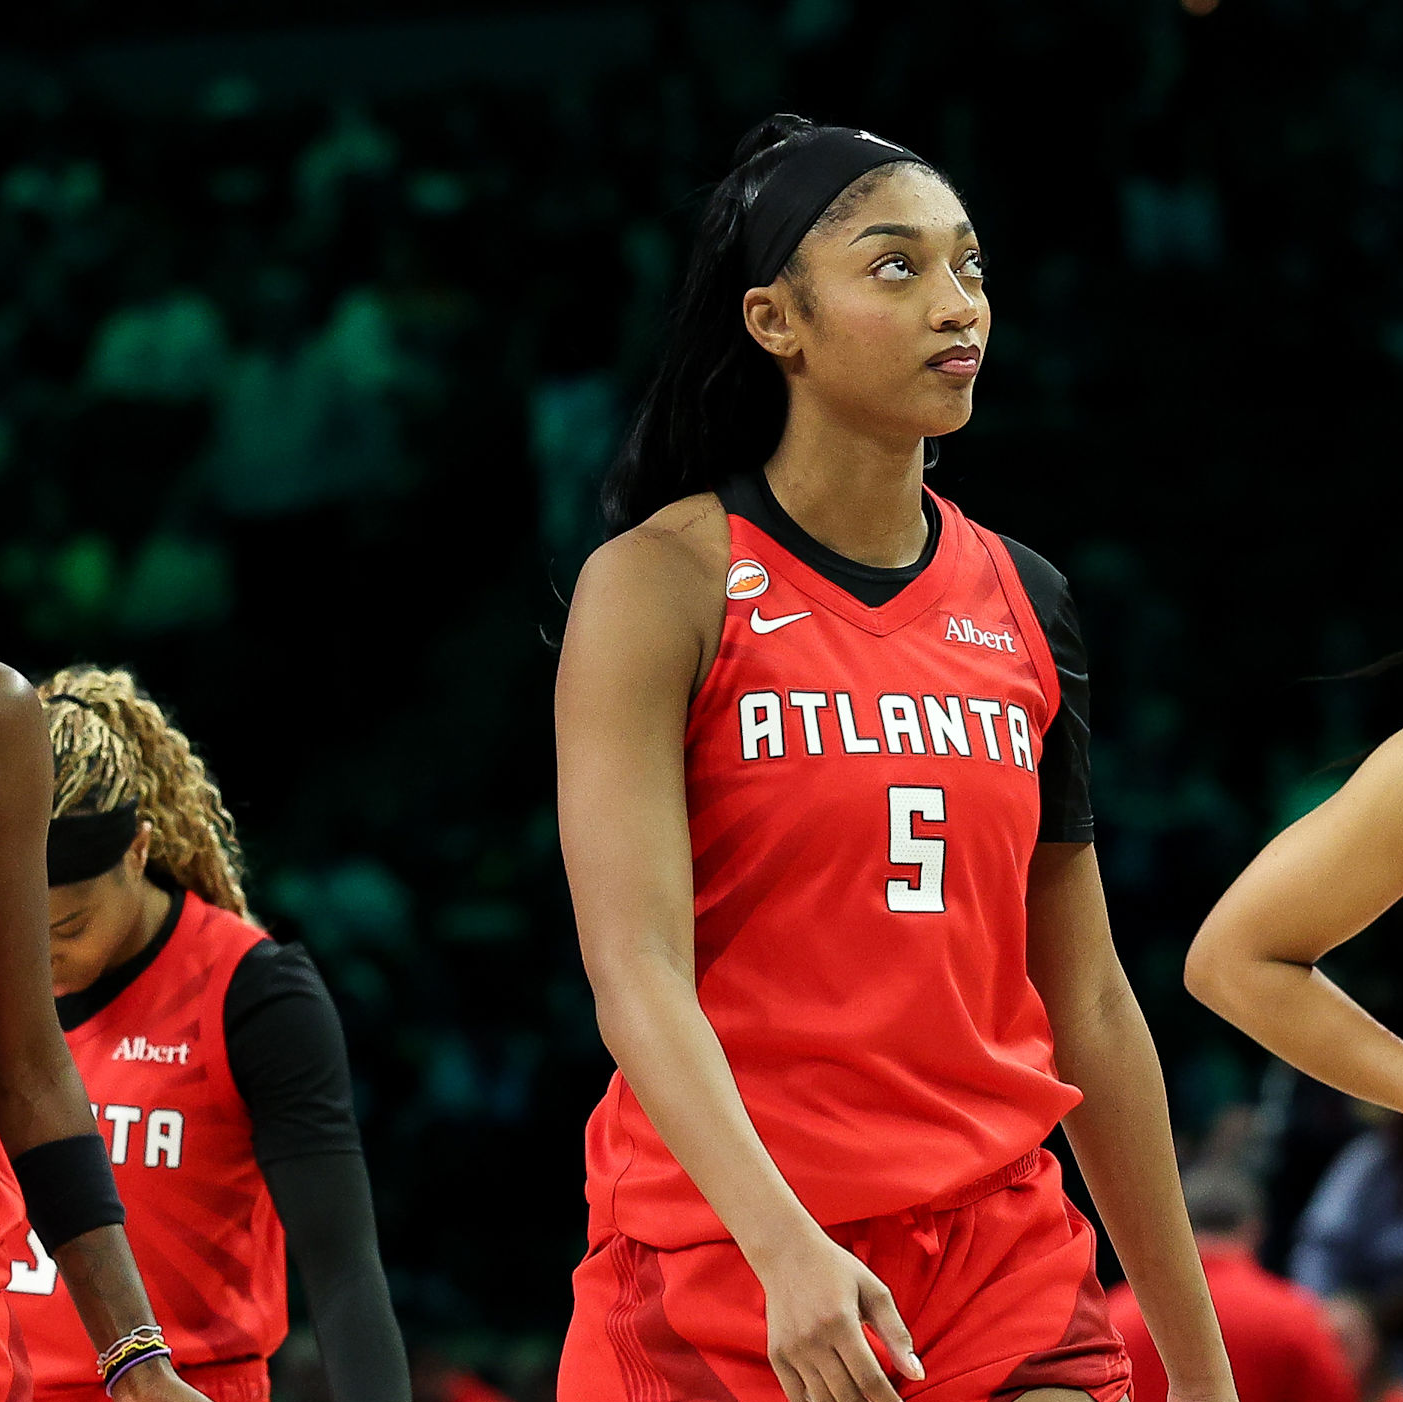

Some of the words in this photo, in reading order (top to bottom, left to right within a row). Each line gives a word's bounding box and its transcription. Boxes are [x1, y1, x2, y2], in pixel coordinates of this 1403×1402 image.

[943, 615, 1018, 654] Albert
[738, 690, 1035, 773] ATLANTA
[885, 786, 946, 913] 5
[110, 1036, 191, 1066] Albert
